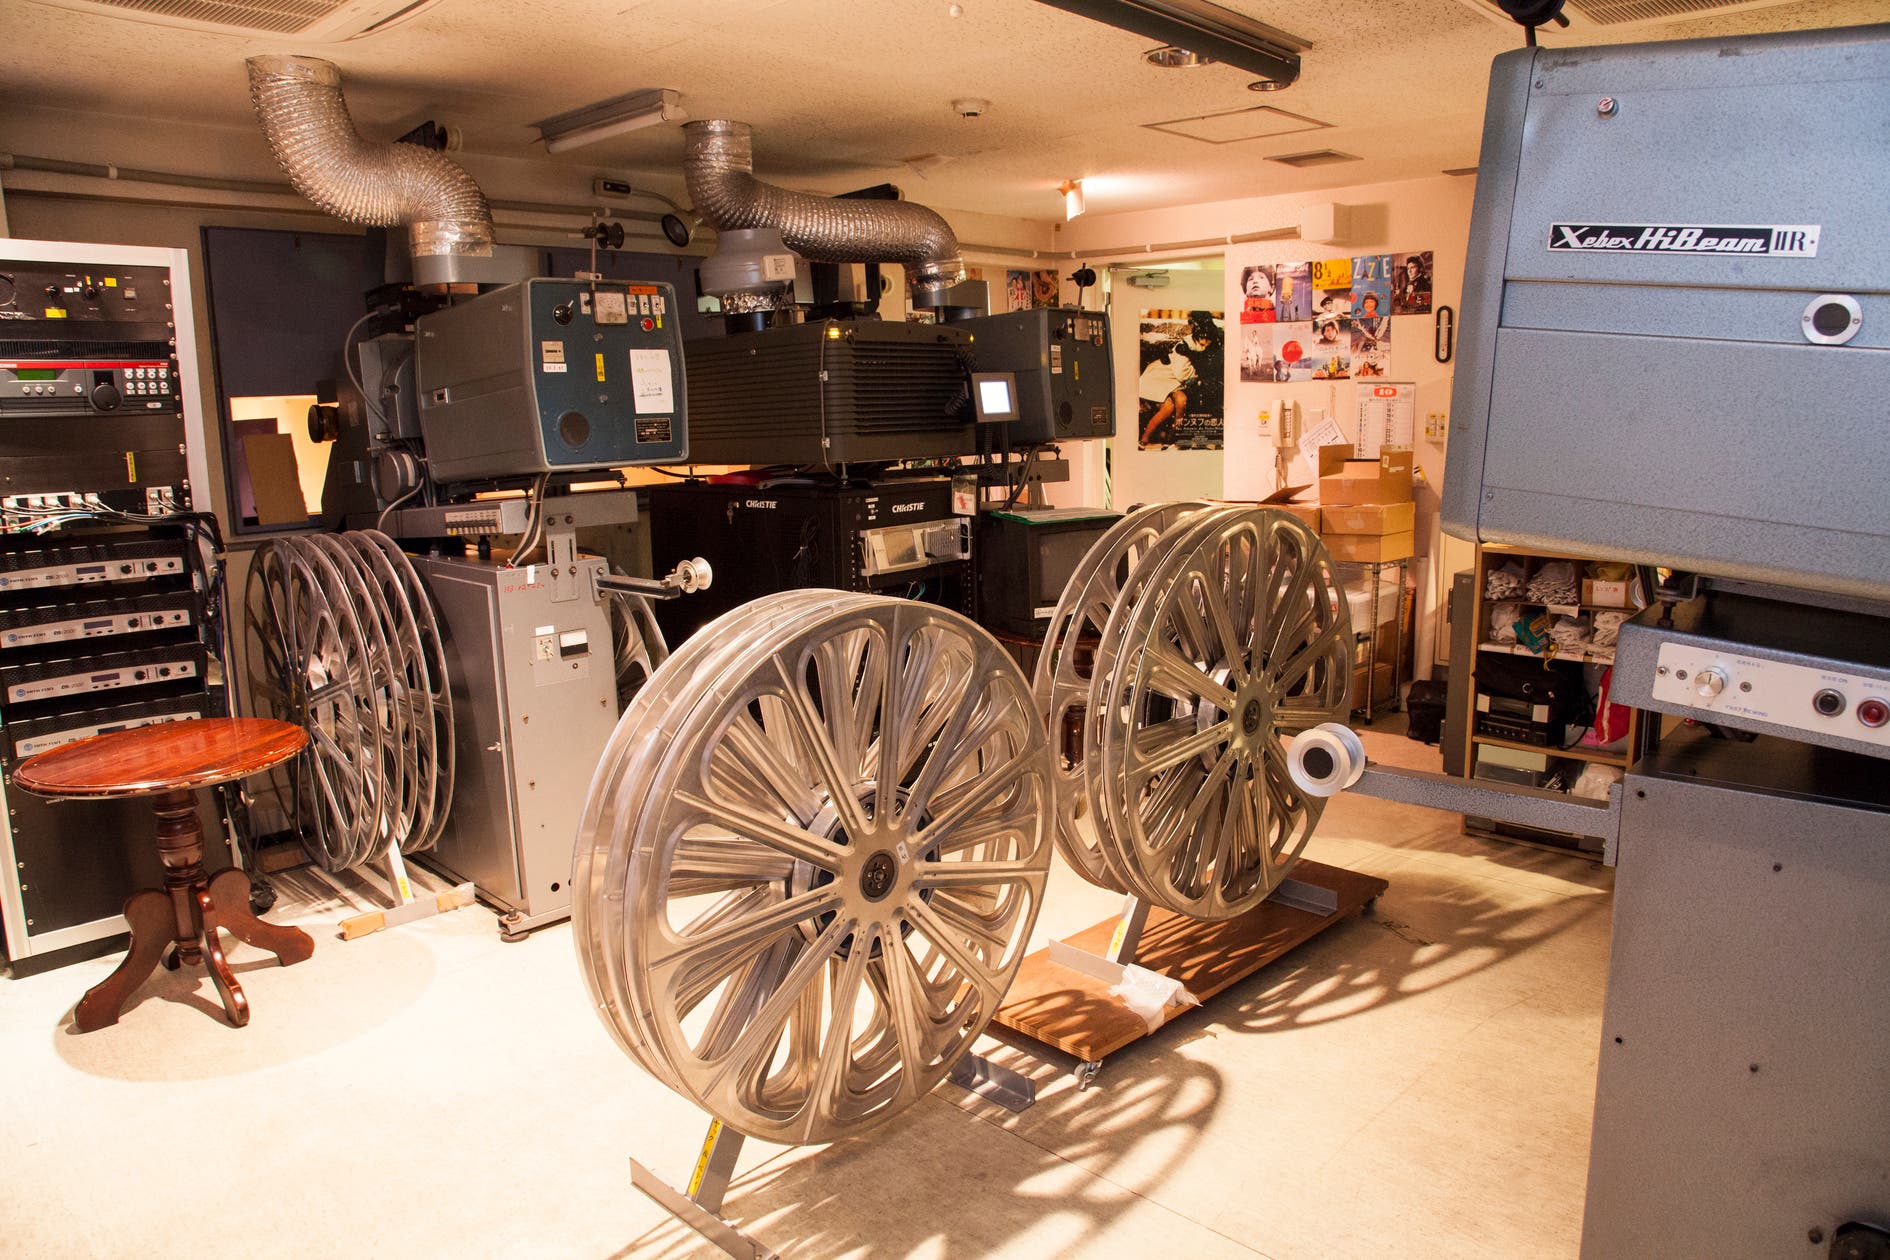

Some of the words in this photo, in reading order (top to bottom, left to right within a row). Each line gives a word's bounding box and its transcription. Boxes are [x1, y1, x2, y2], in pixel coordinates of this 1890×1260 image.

[1552, 226, 1635, 249] Xebex
[1633, 227, 1768, 253] HiBeam
[745, 498, 778, 509] CHRISTIE
[891, 501, 926, 514] CHRISTIE
